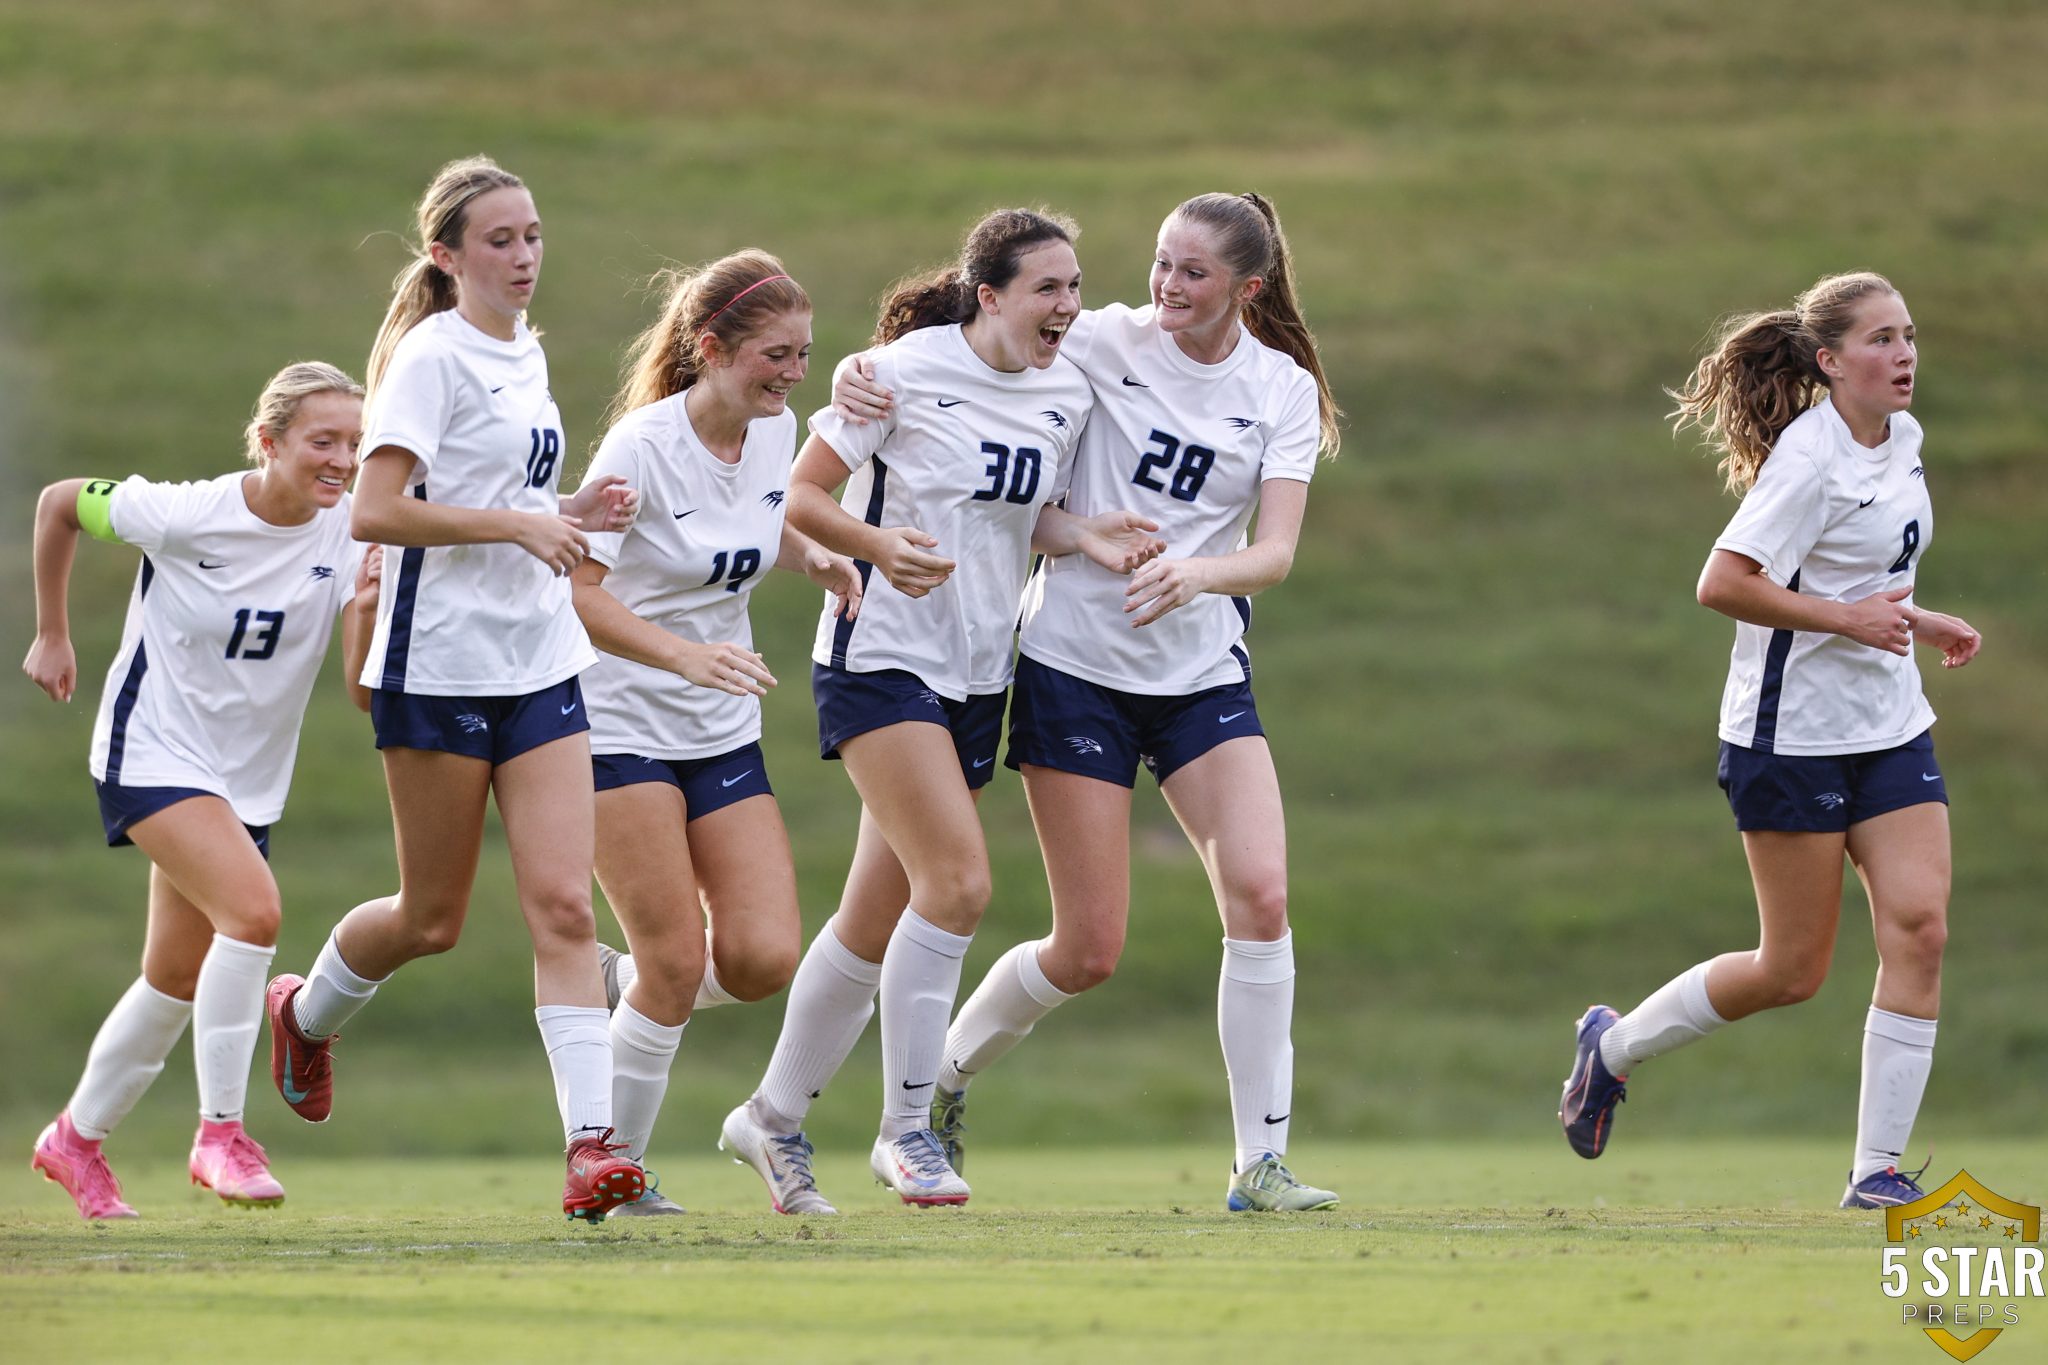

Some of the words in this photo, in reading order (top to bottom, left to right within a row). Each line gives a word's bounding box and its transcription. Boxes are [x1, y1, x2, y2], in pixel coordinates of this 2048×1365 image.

[523, 427, 559, 488] 18
[969, 441, 1041, 506] 30
[1131, 428, 1216, 502] 28
[86, 480, 118, 496] C
[702, 548, 761, 594] 19
[1888, 519, 1919, 574] 8
[225, 608, 286, 660] 13
